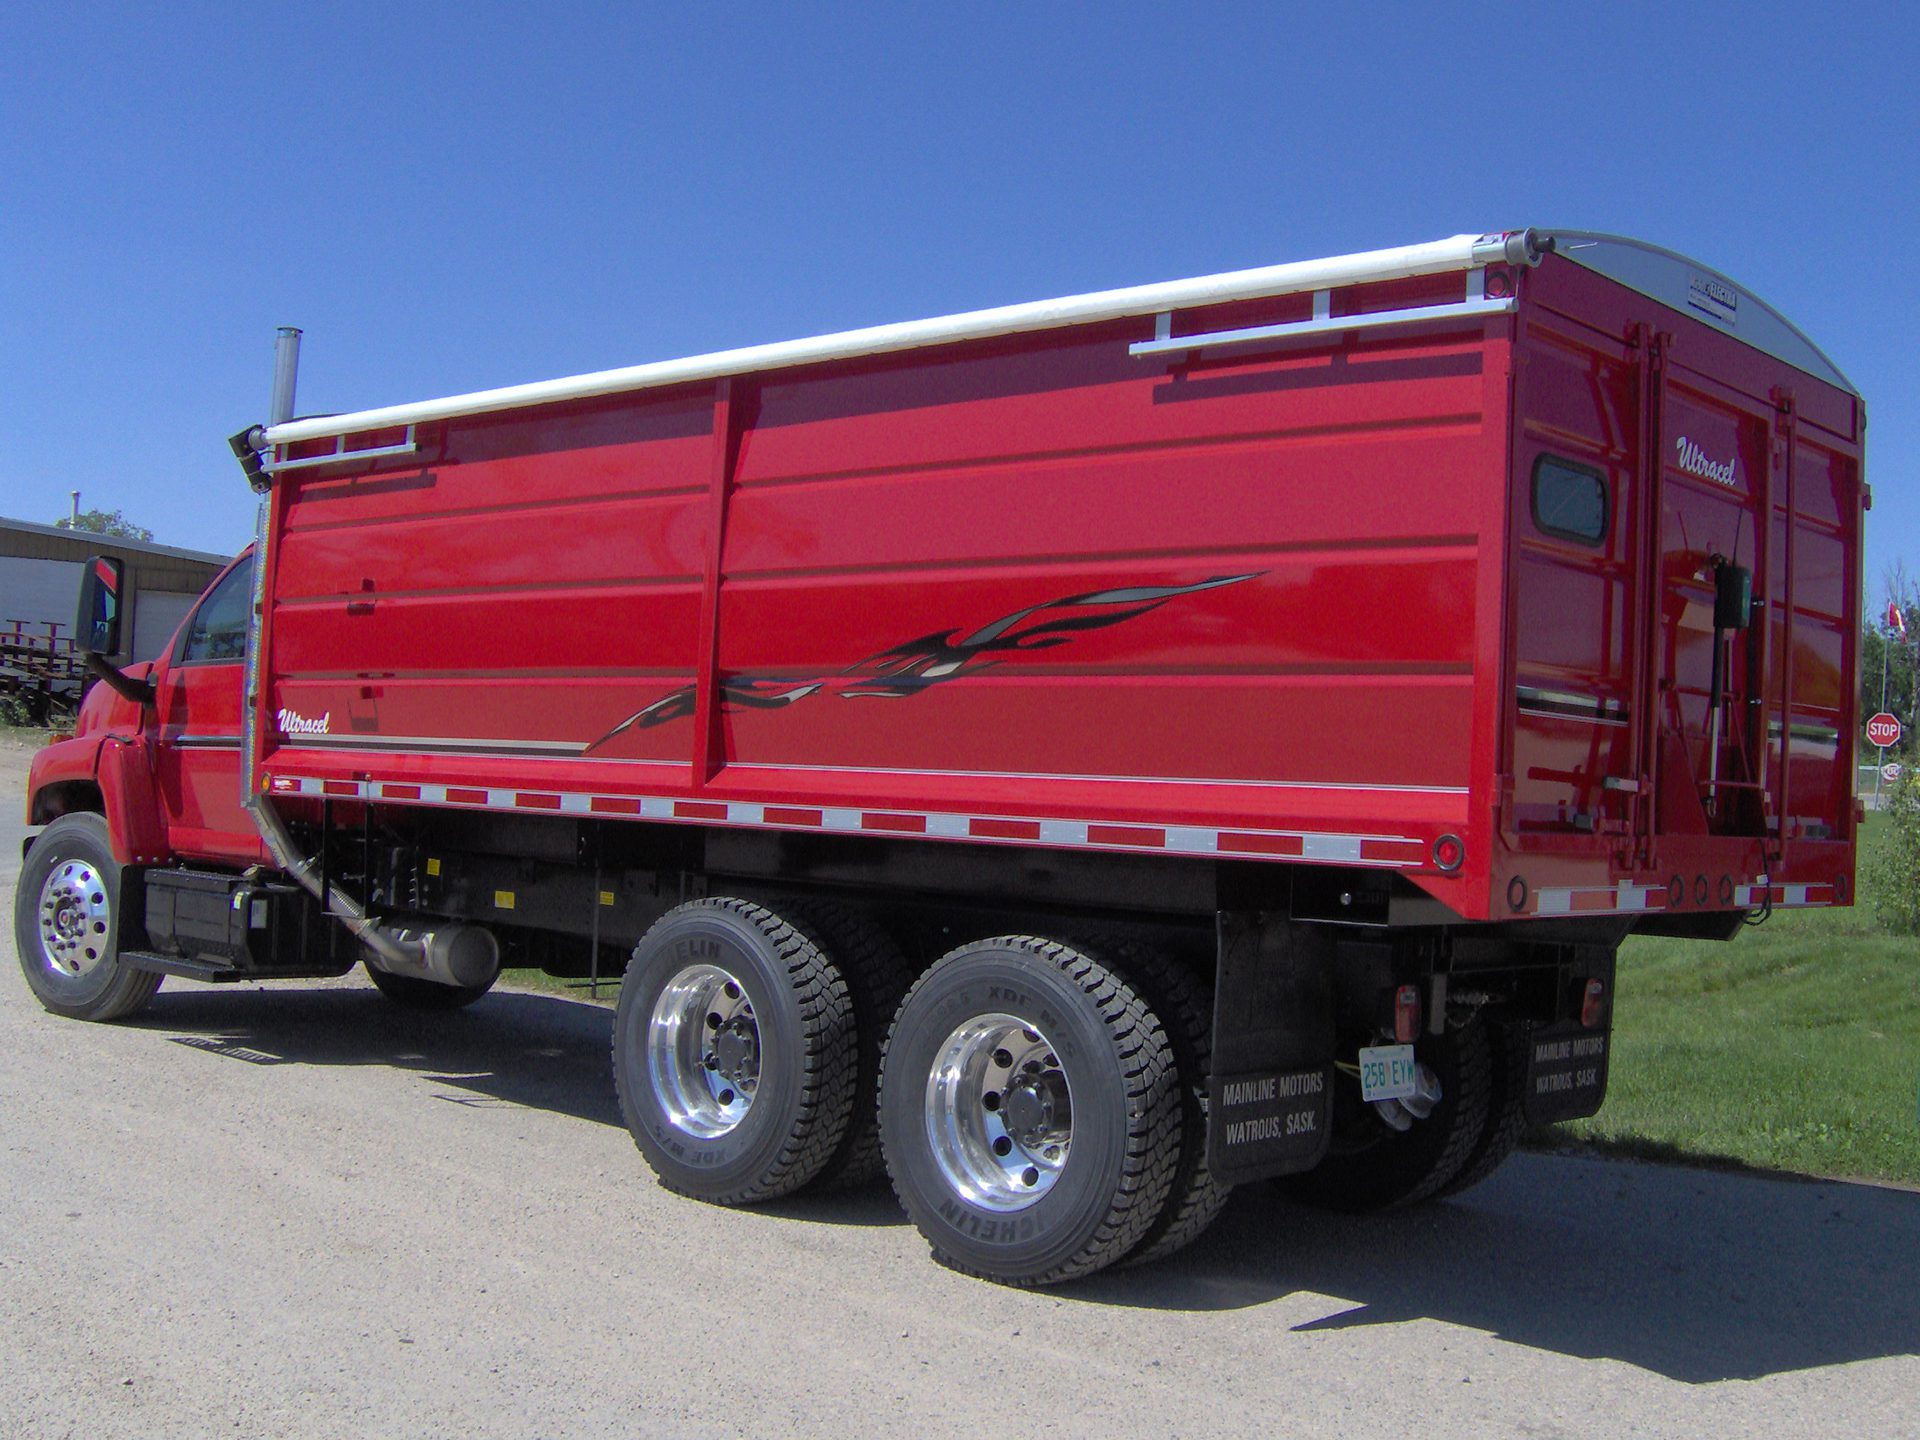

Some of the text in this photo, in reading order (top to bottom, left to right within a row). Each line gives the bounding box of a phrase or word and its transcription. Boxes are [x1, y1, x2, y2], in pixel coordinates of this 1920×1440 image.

[1676, 436, 1736, 486] Ultracel
[277, 708, 330, 733] Ultracel
[1870, 722, 1898, 737] STOP
[1535, 1041, 1570, 1063] MAINLINE
[1223, 1071, 1323, 1106] MAINLINE MOTORS
[1363, 1062, 1386, 1089] 258
[1226, 1110, 1316, 1145] WATROUS, SASK.
